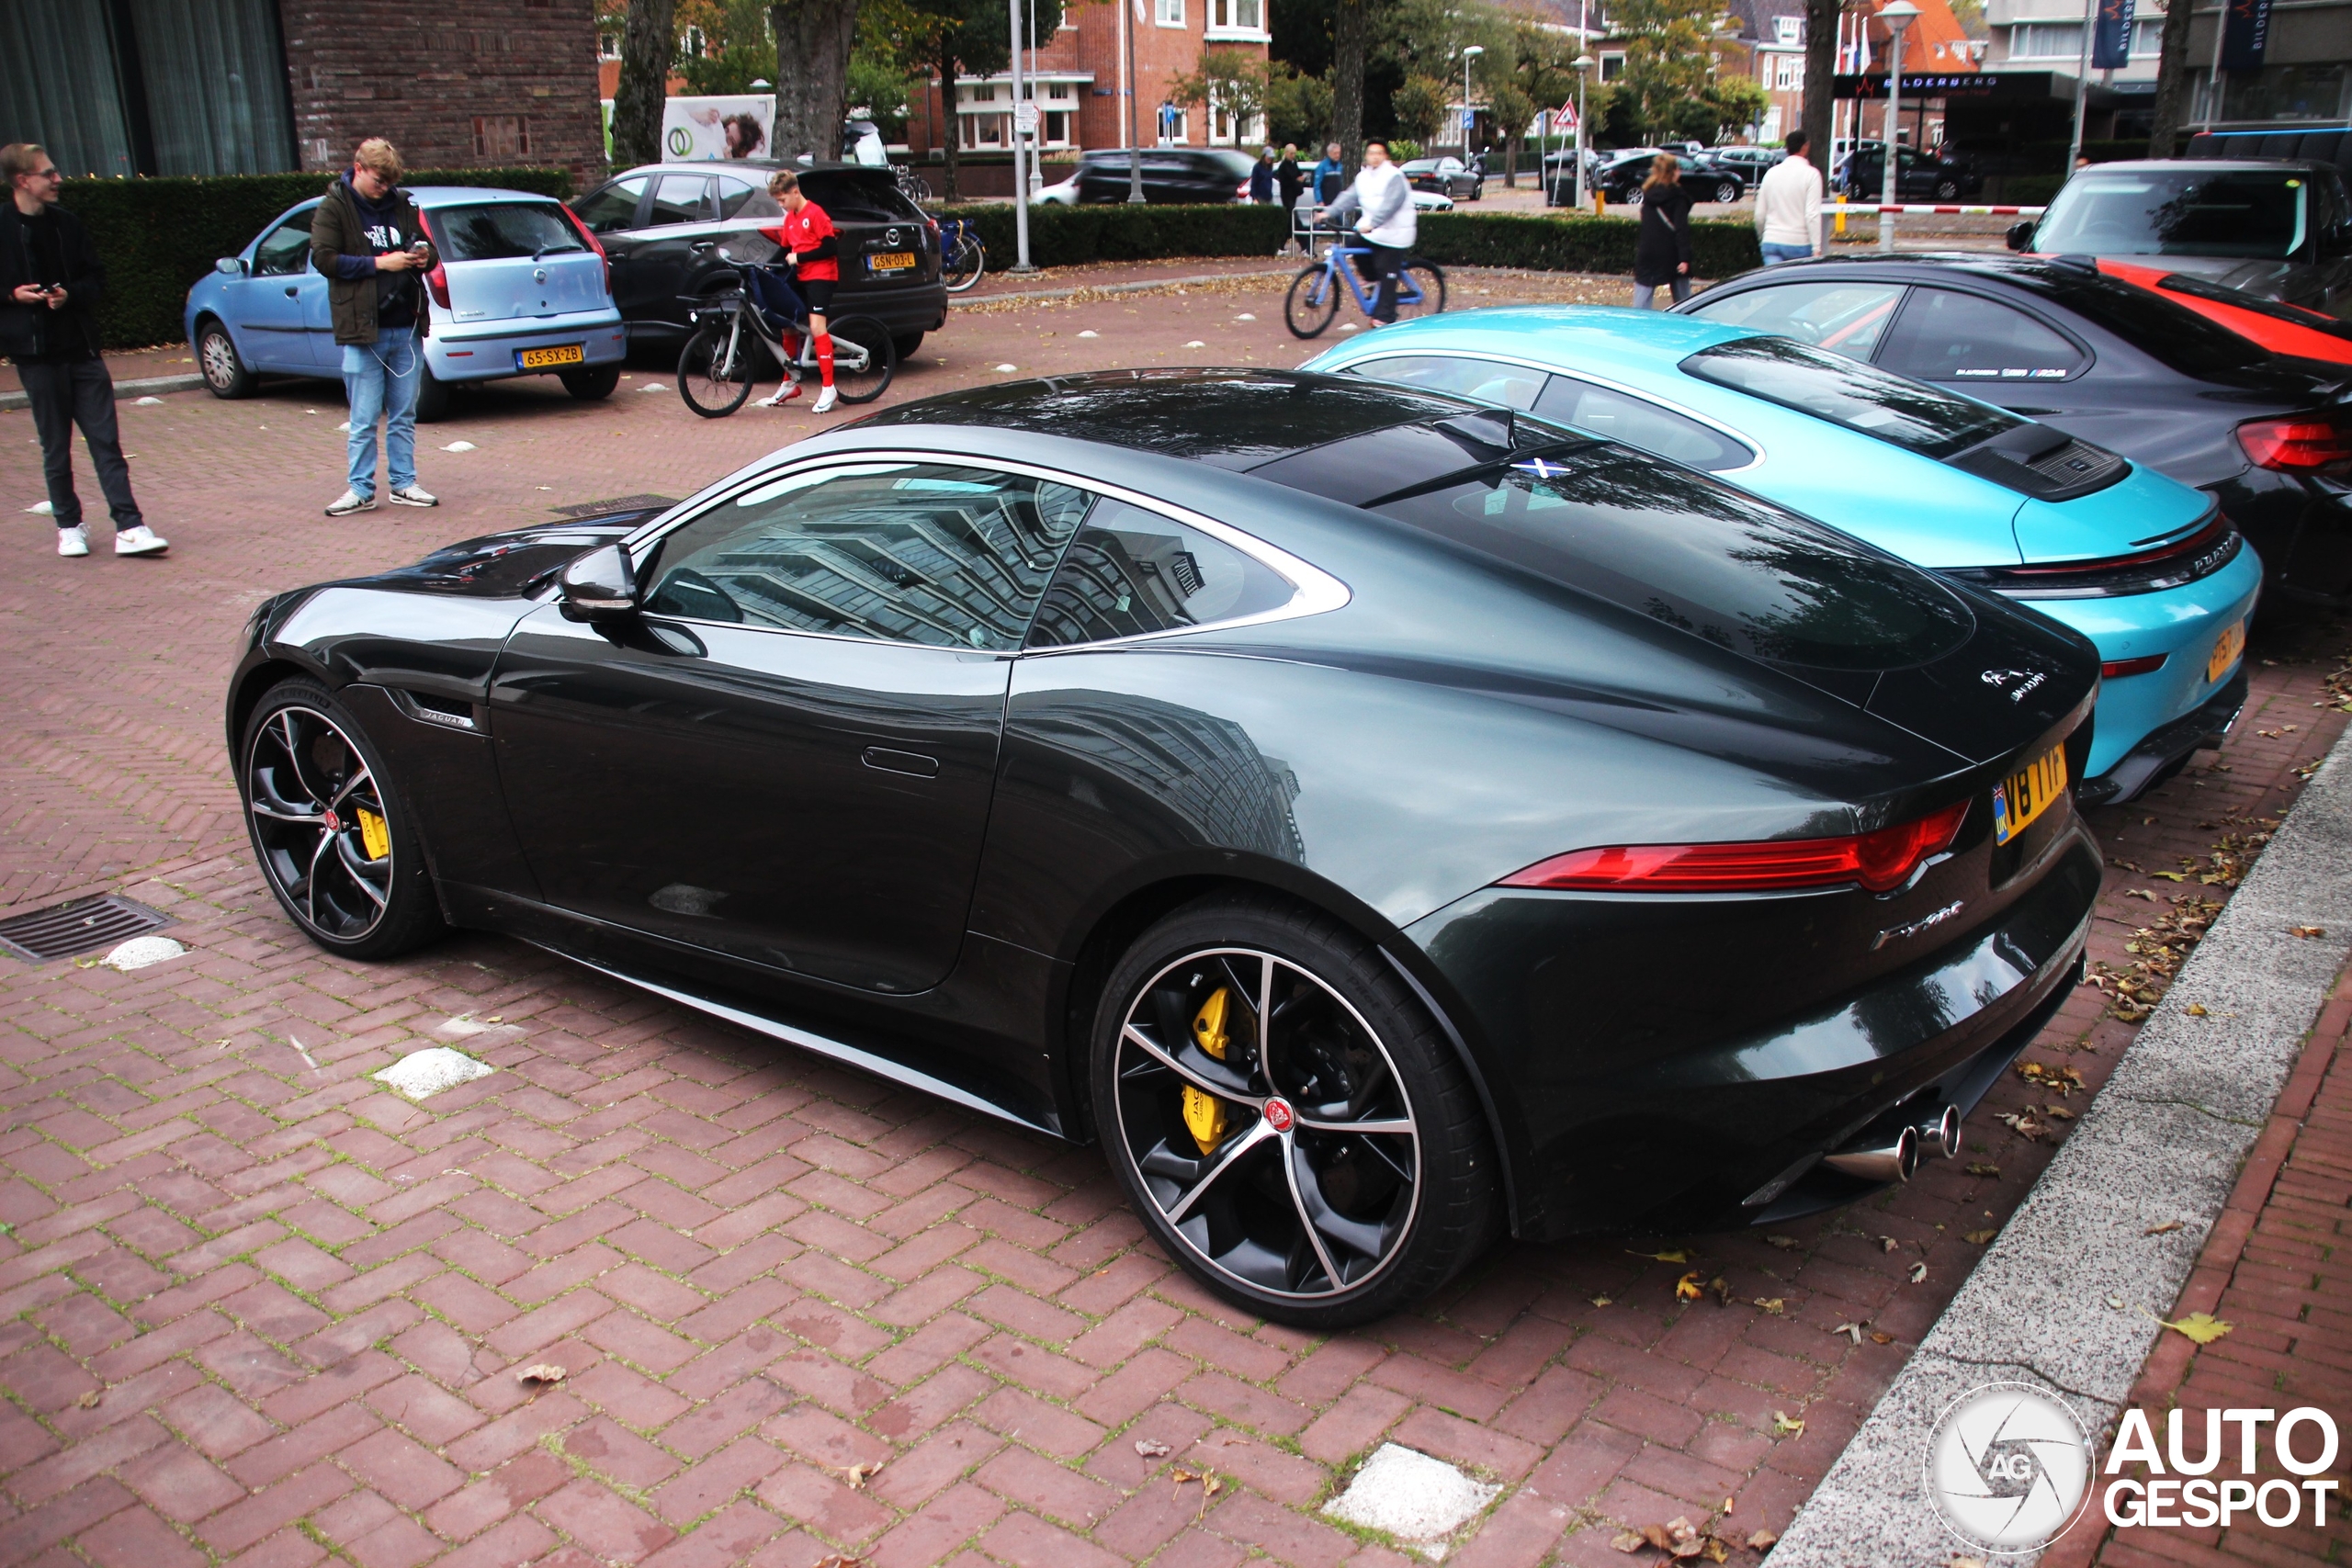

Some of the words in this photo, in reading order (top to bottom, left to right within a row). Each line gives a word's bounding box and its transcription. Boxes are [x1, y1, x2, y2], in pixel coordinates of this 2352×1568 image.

[1883, 77, 1996, 88] BLDERBERG
[527, 347, 579, 365] 65-SX-ZB
[2003, 768, 2031, 827] V8
[1996, 813, 2007, 835] UK
